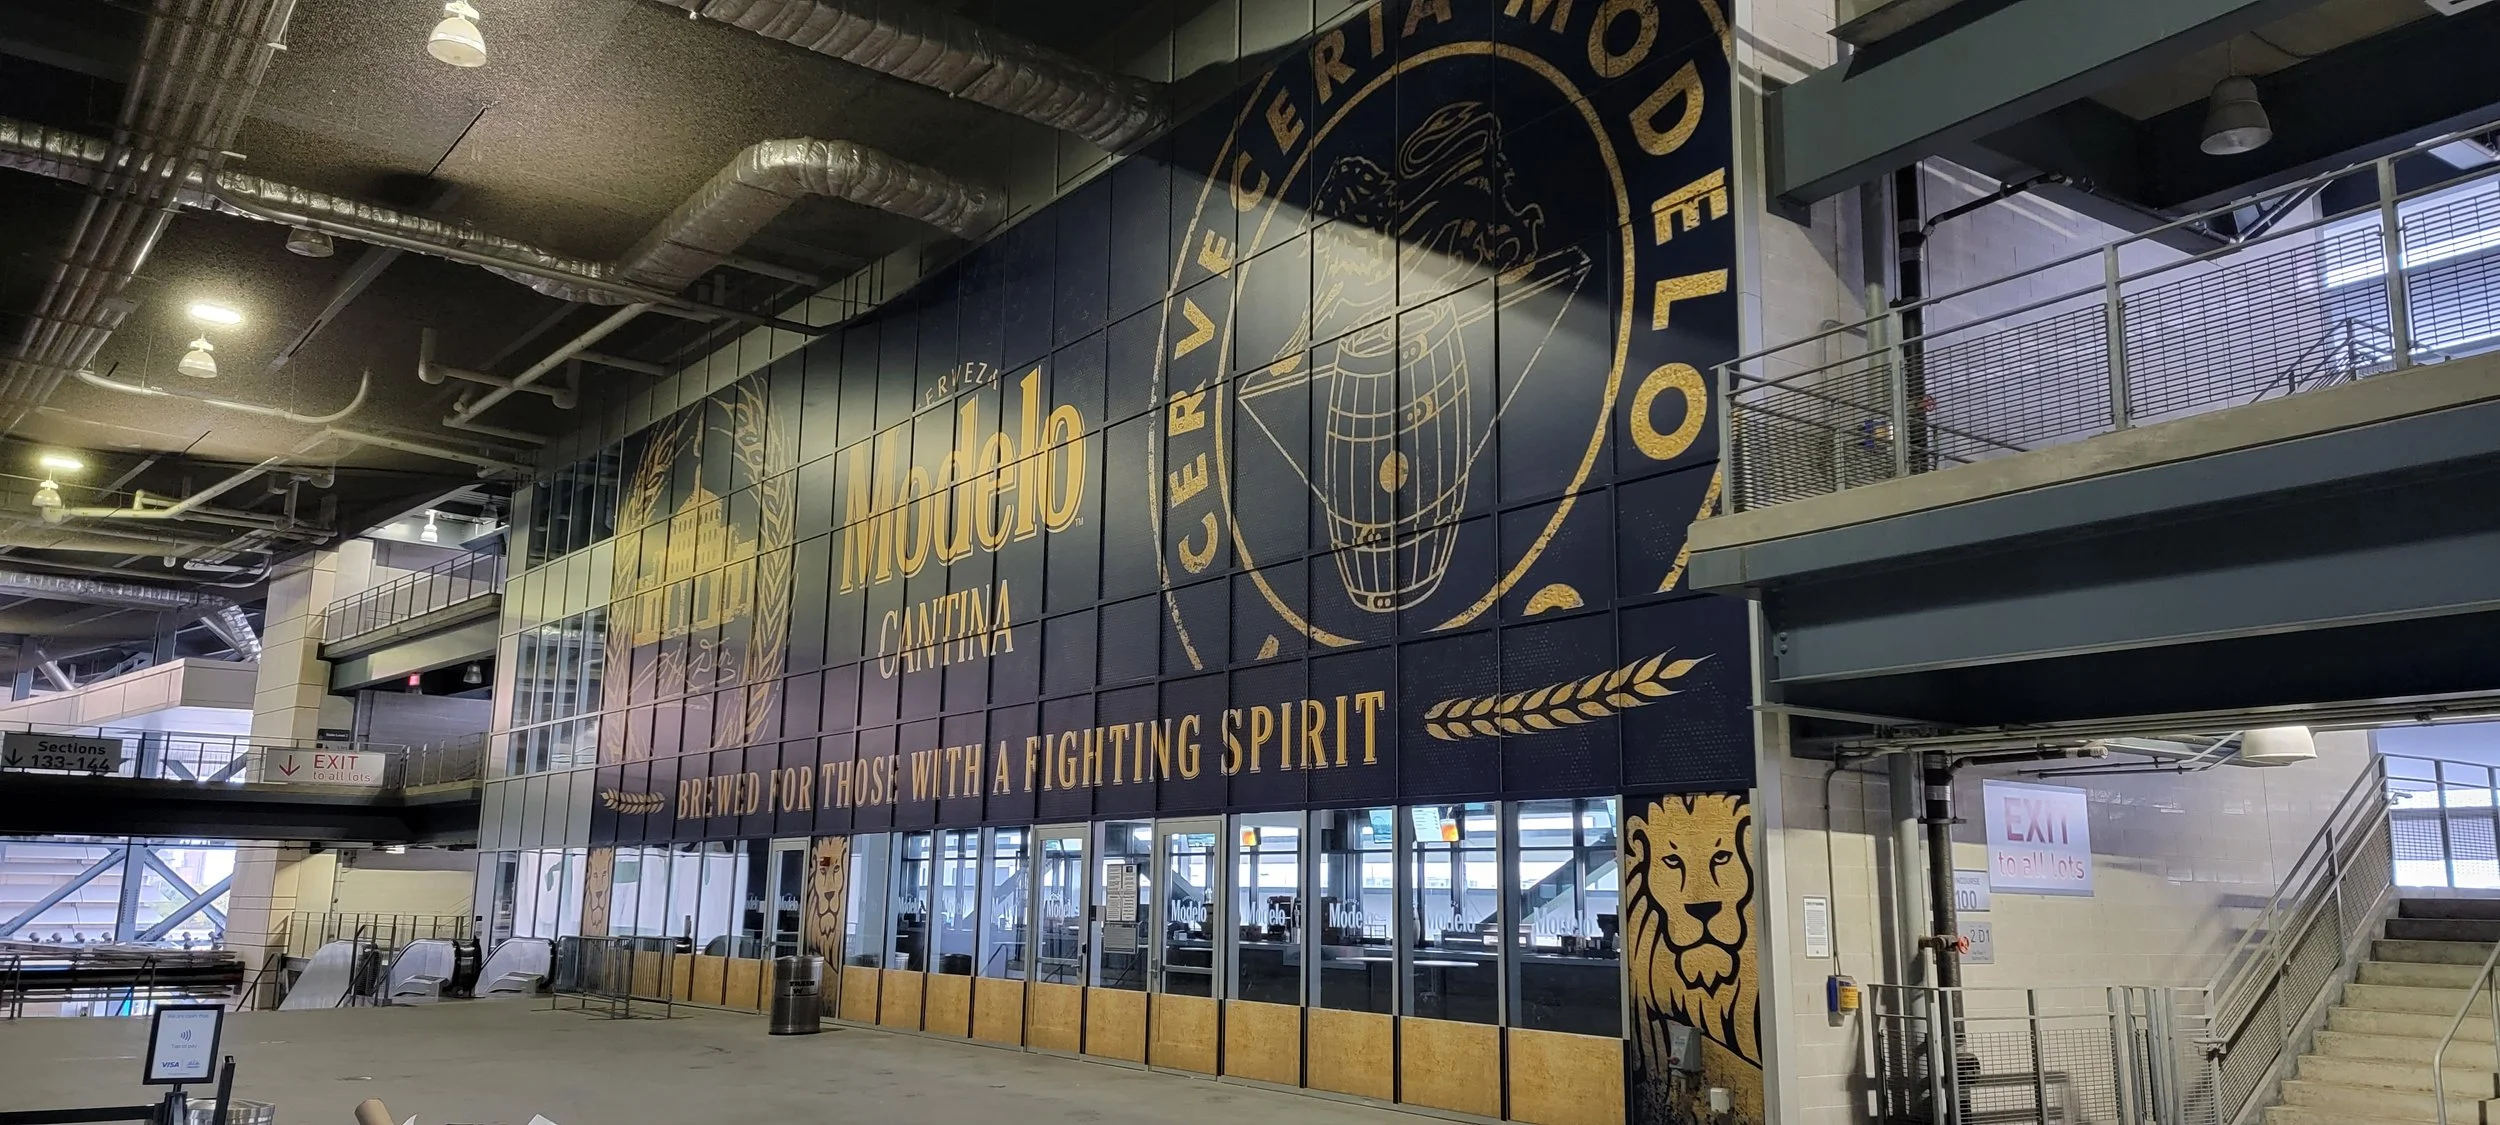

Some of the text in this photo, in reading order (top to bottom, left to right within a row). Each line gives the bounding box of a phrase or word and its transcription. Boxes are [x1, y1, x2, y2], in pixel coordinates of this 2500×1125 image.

[839, 364, 1087, 596] Modelo
[879, 578, 1015, 680] CANTINA
[38, 741, 106, 755] Sections
[677, 690, 1385, 821] BREWED FOR THOSE WITH A FIGHTING SPIRIT
[31, 754, 110, 771] 133-144
[313, 754, 359, 770] EXIT
[313, 771, 371, 782] to all lots
[2003, 796, 2071, 845] EXIT
[1998, 851, 2085, 879] to all lots
[1171, 900, 1207, 923] Modelo
[1956, 890, 1977, 910] 100
[1328, 902, 1364, 929] Mode
